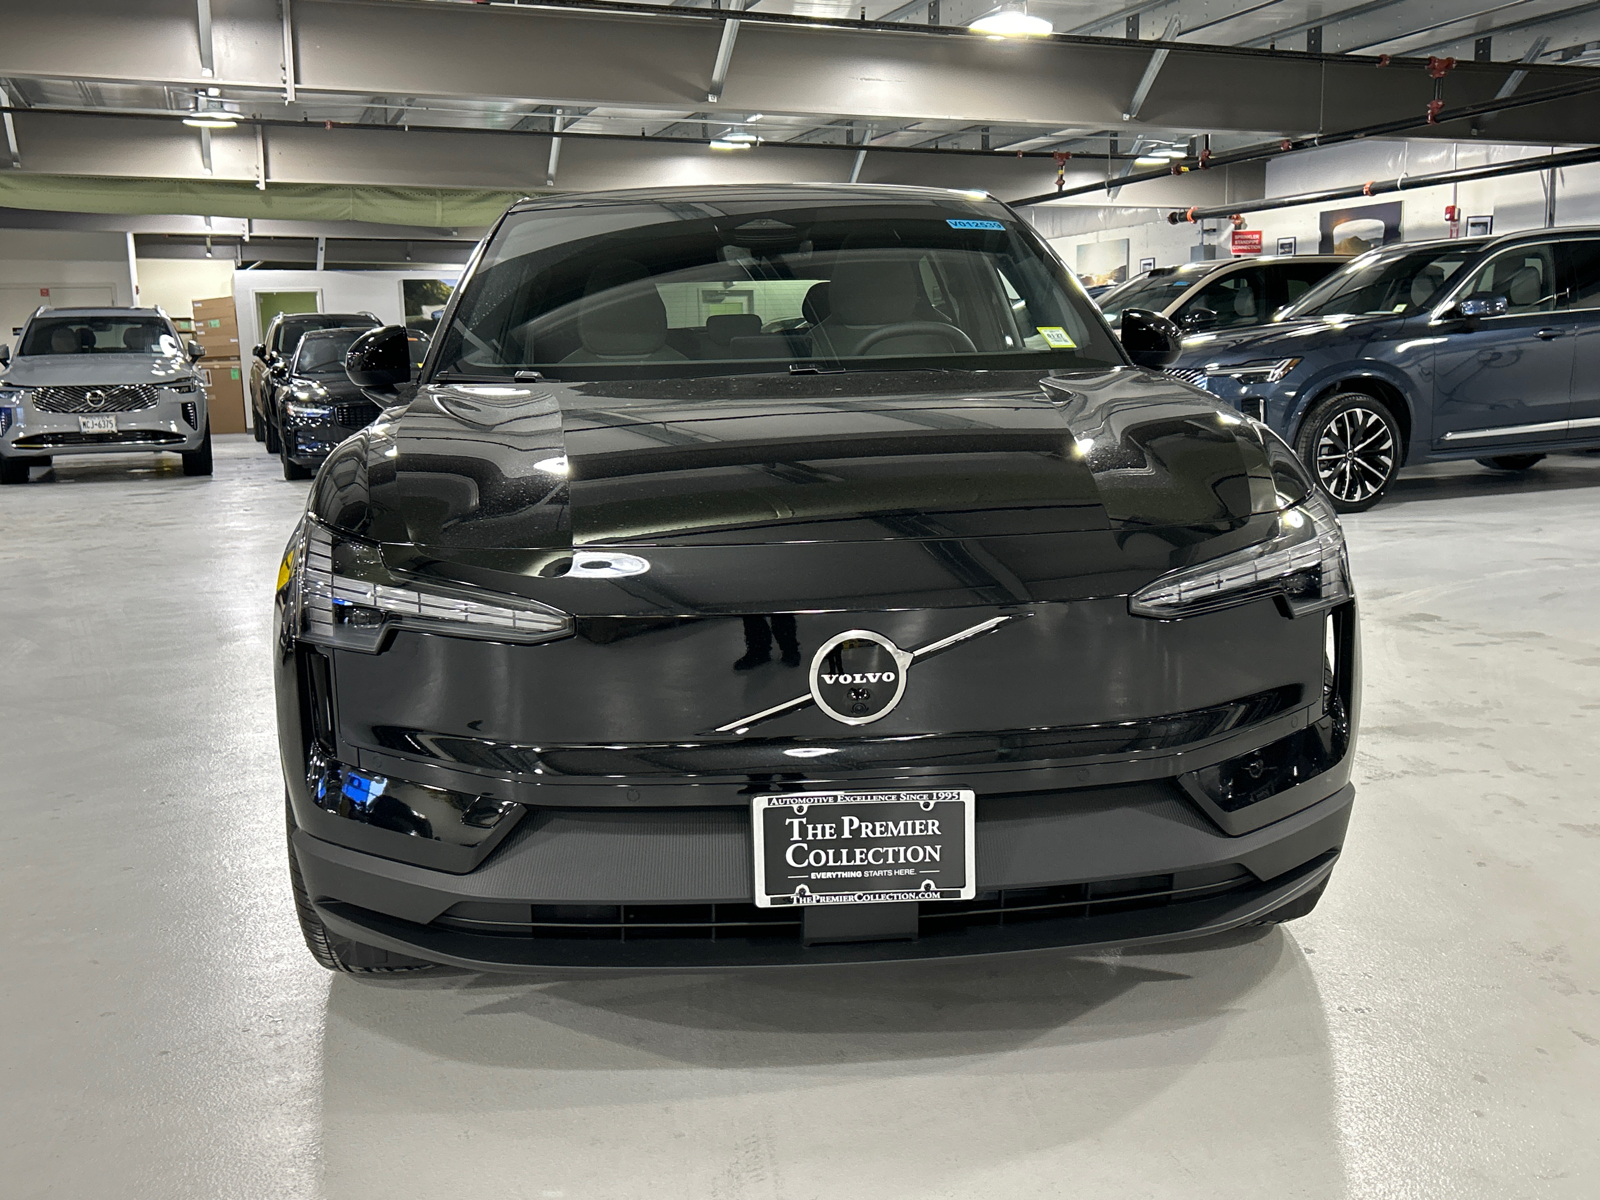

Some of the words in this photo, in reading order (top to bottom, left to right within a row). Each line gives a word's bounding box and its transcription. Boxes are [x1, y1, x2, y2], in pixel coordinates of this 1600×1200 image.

[820, 672, 896, 685] VOLVO
[770, 796, 835, 806] Automotive
[837, 794, 897, 804] Excellence
[900, 793, 929, 801] Since
[932, 792, 959, 800] 1995
[785, 817, 837, 841] The
[841, 815, 942, 839] Premier
[785, 842, 942, 868] Collection
[810, 871, 863, 880] EVERYTHING
[863, 869, 893, 878] STARTS
[893, 868, 917, 876] HERE.
[790, 891, 942, 905] ThePremierCollection.com
